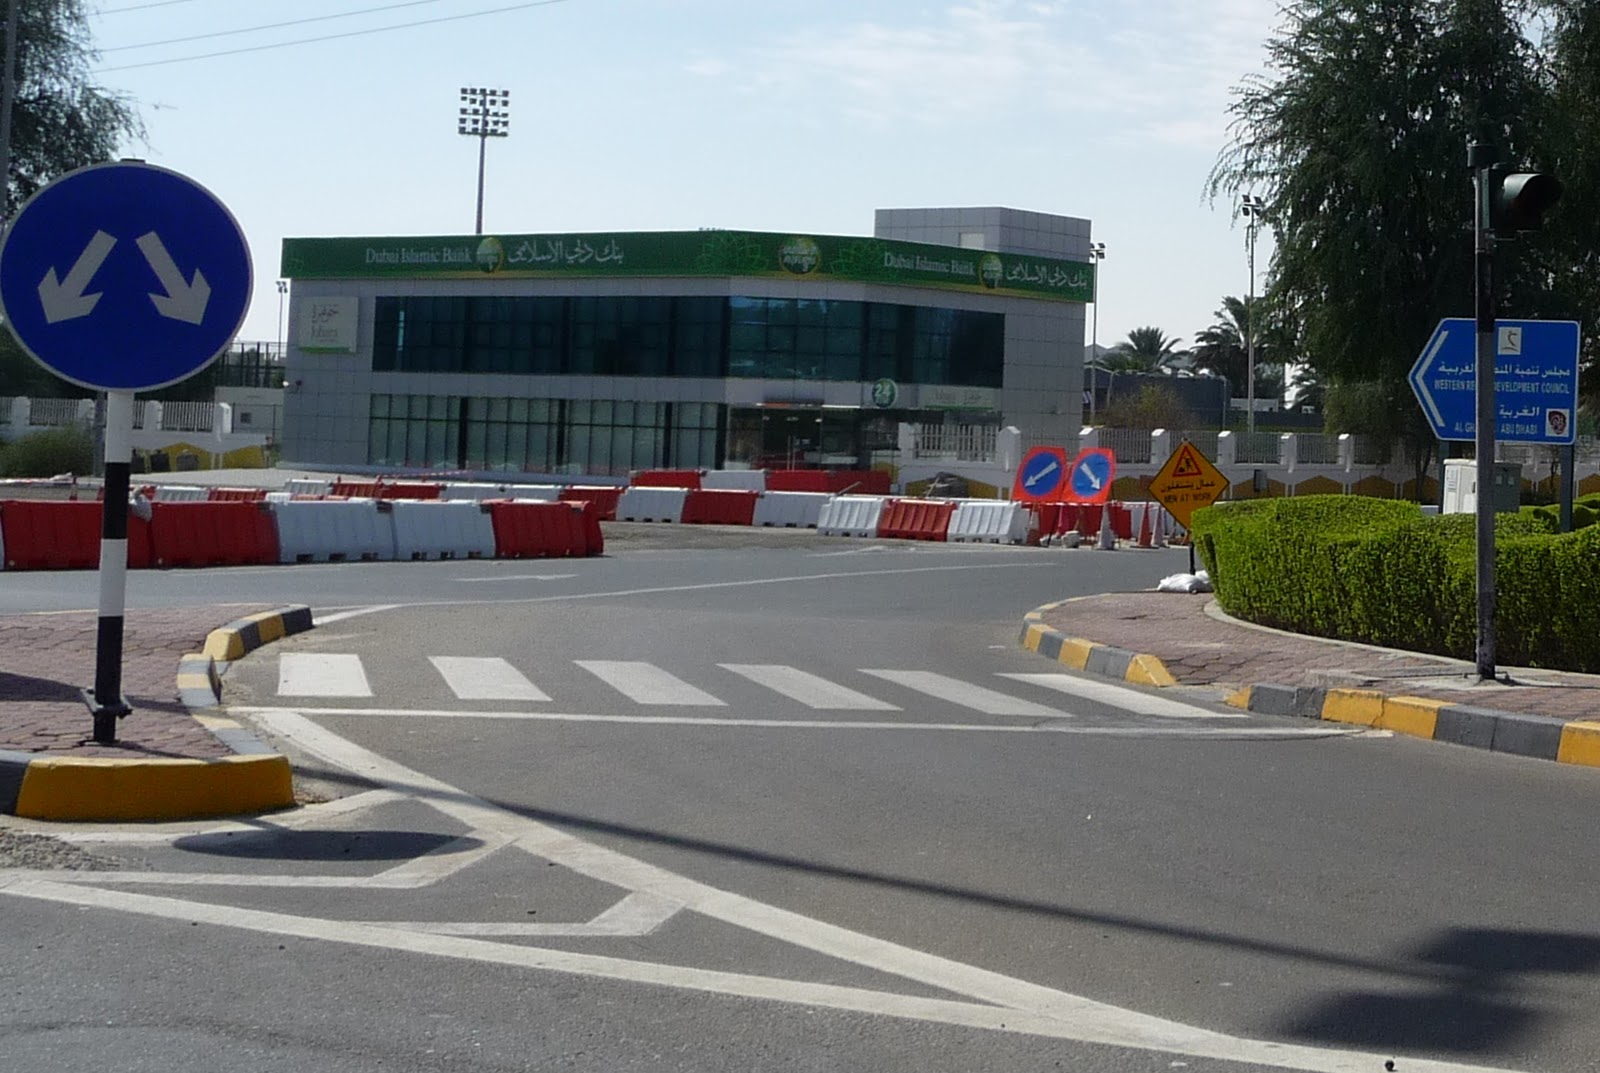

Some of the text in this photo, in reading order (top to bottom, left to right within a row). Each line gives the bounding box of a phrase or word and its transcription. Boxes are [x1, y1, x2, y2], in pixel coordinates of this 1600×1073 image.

[365, 247, 472, 264] Dubai Islamic Bank
[883, 251, 975, 276] Dubai Islamic Bank
[1541, 366, 1571, 378] مجلس
[874, 383, 892, 397] 24
[1434, 379, 1465, 391] WESTERN
[1541, 382, 1570, 395] COUNCIL
[1499, 404, 1540, 418] الغربية
[1500, 423, 1538, 435] ABU DHABI
